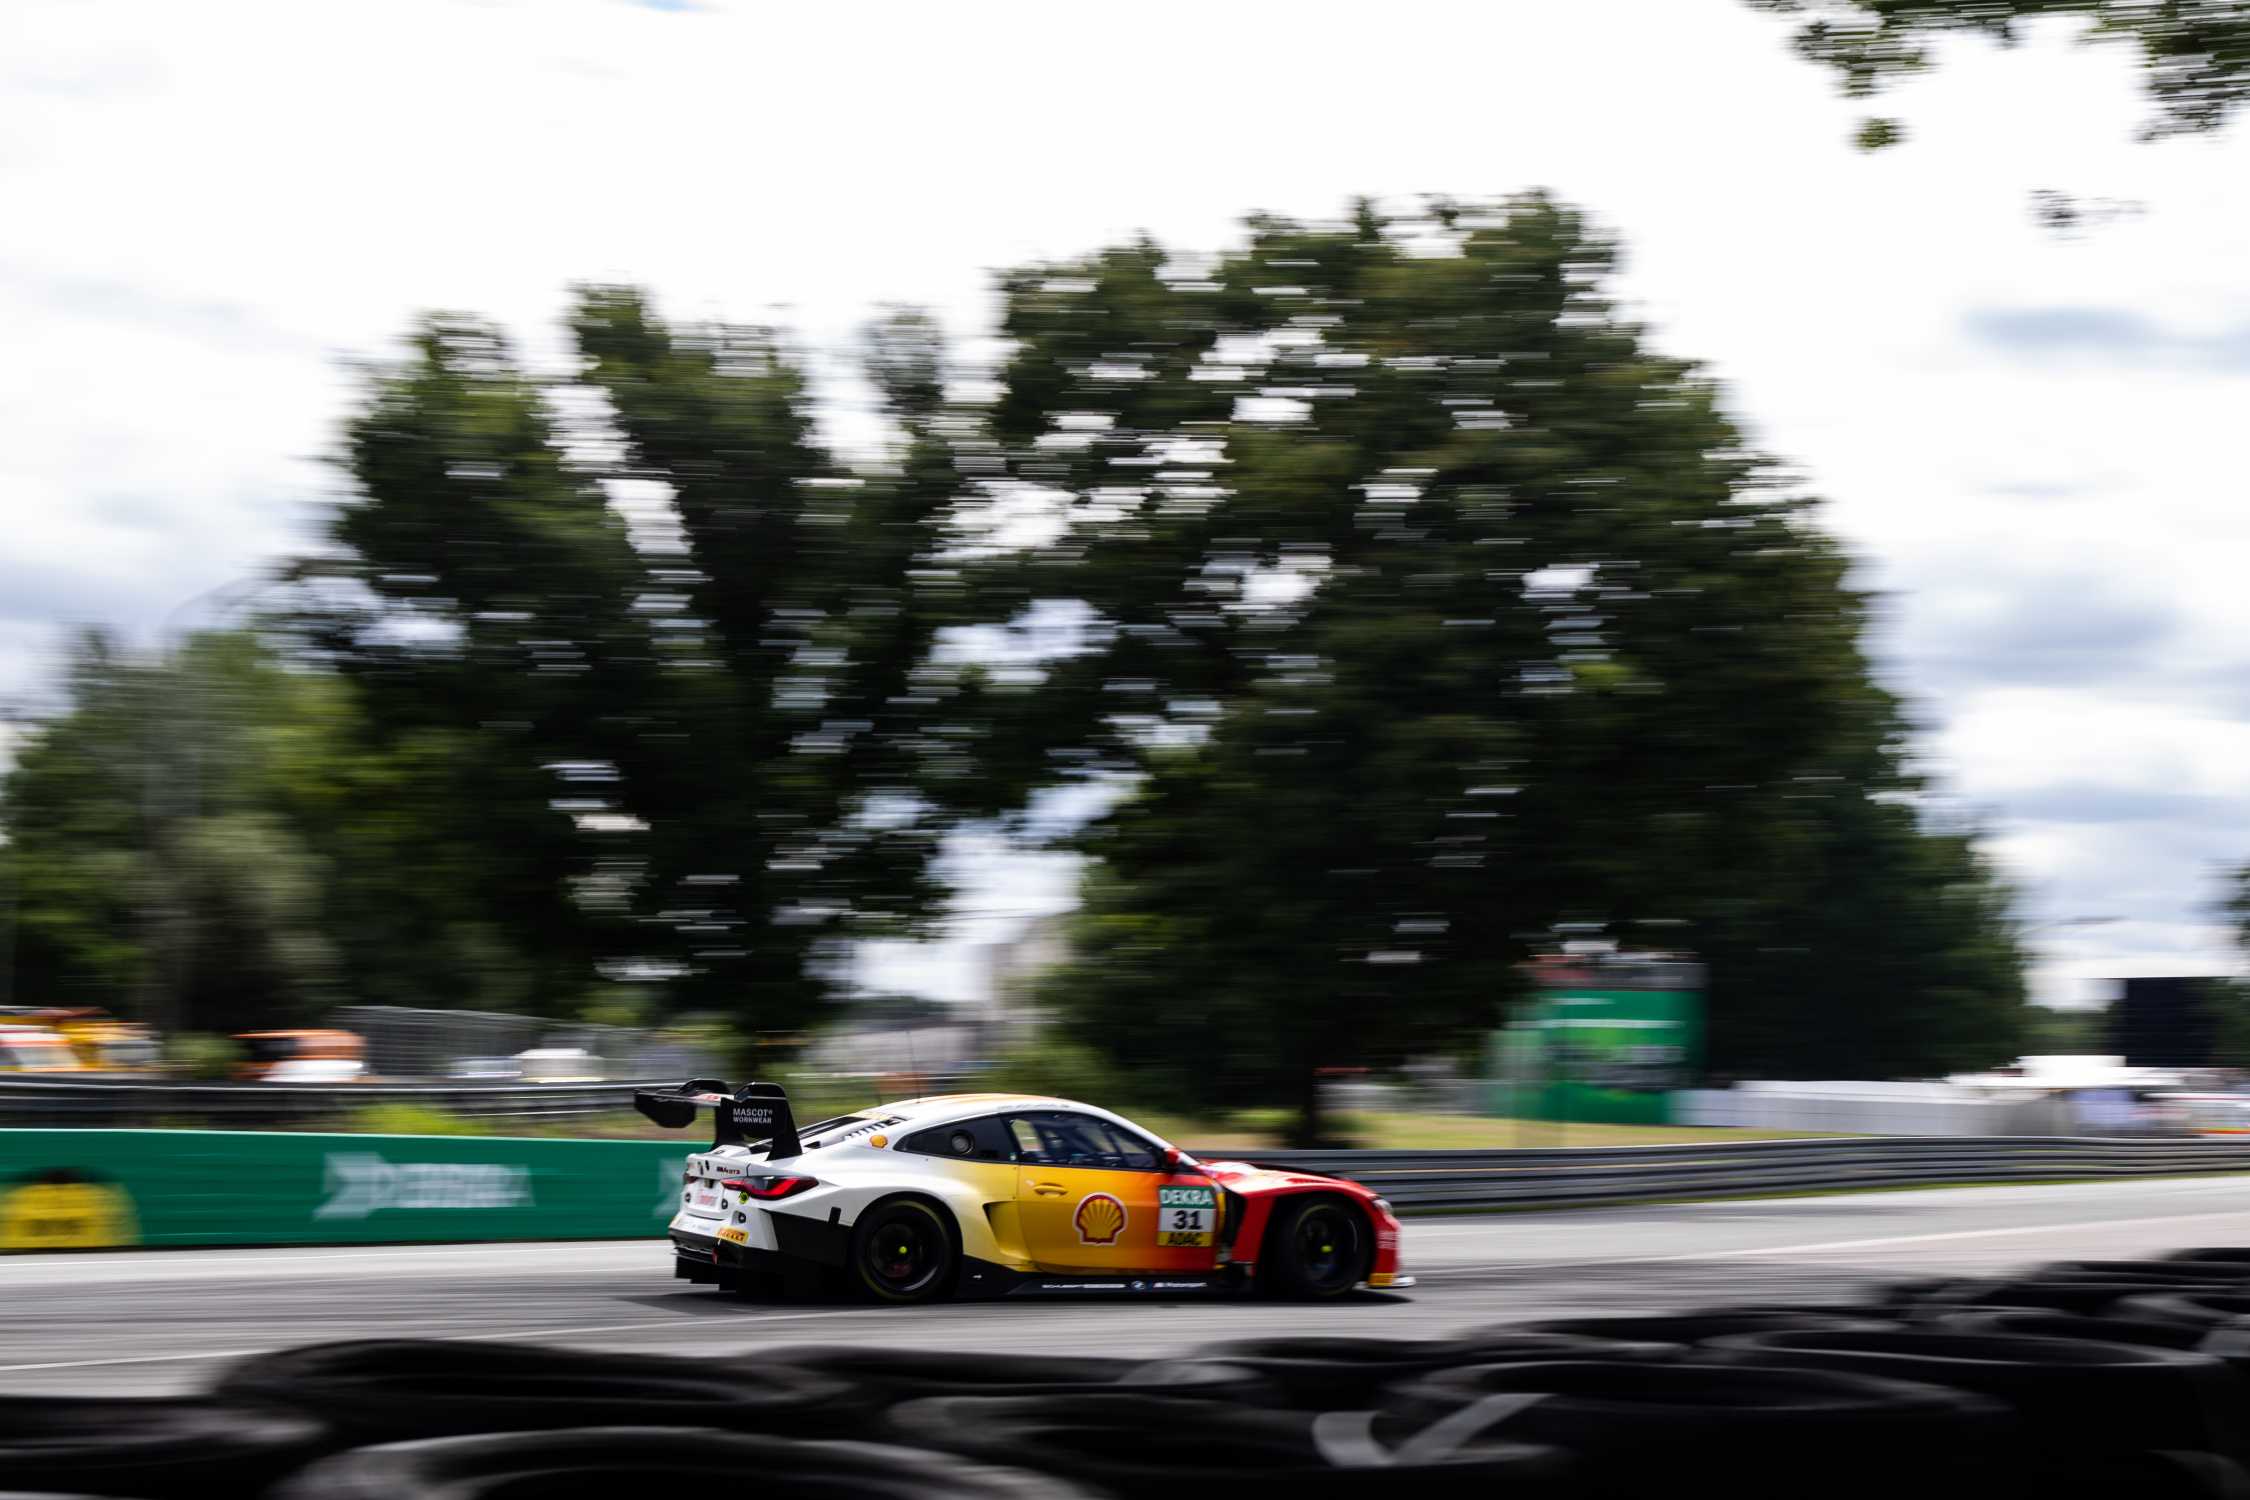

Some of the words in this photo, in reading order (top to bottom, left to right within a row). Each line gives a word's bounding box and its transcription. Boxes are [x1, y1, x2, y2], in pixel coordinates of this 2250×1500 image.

[733, 1116, 772, 1124] WORKWEAR
[1160, 1189, 1214, 1204] DEKRA
[1174, 1210, 1202, 1230] 31
